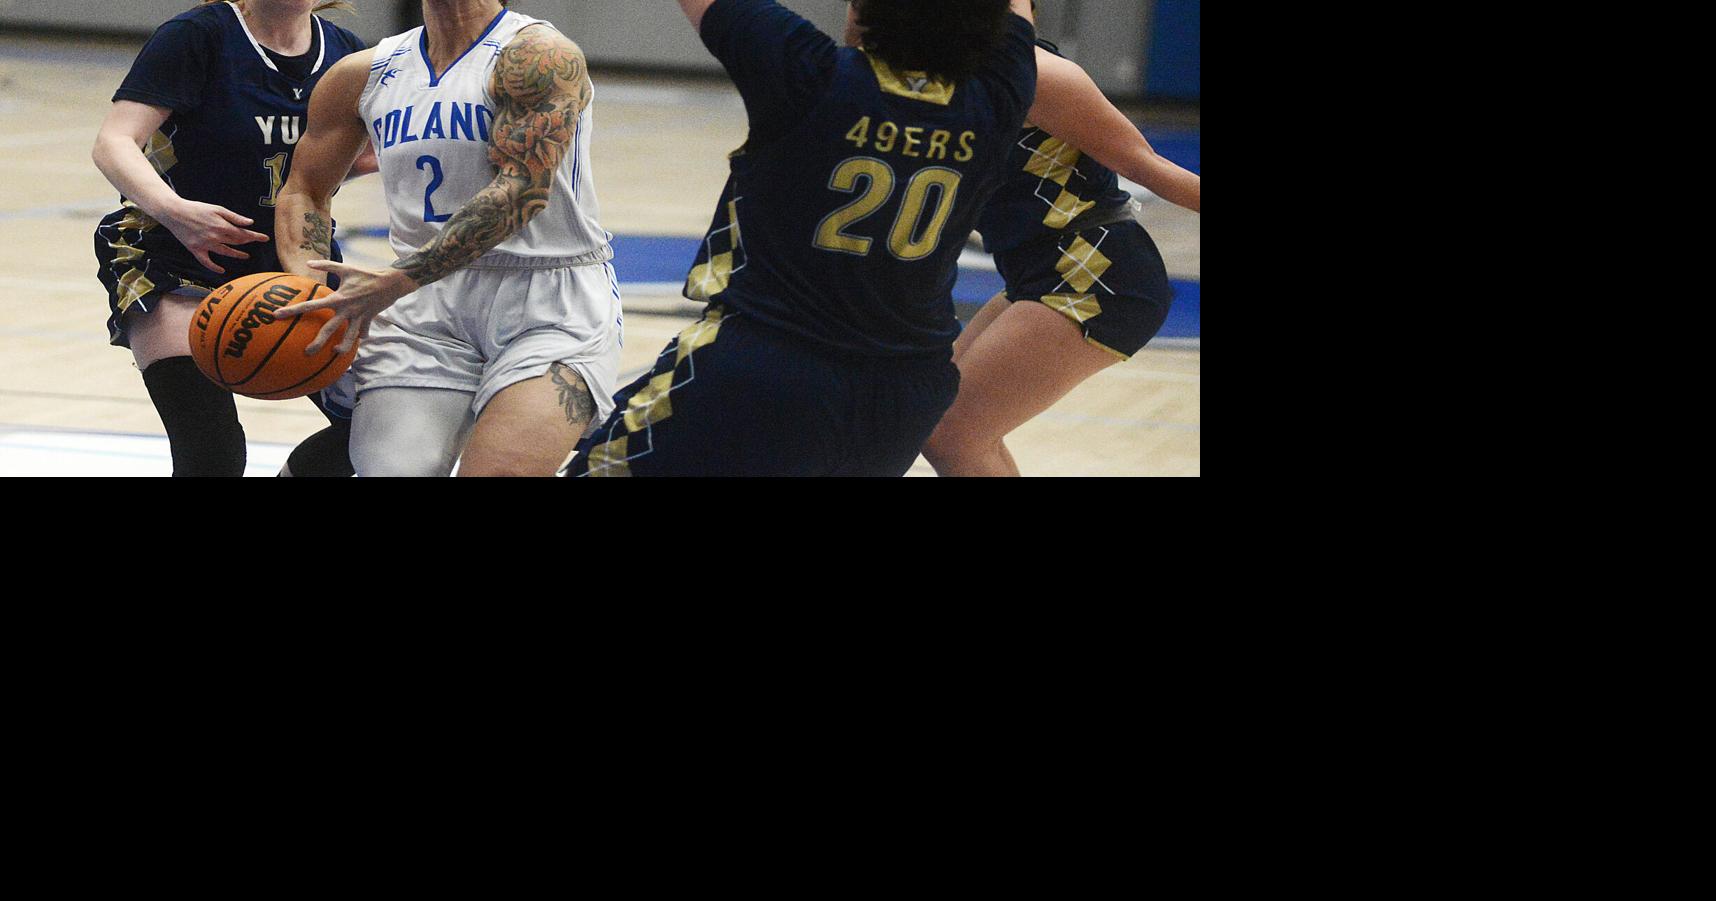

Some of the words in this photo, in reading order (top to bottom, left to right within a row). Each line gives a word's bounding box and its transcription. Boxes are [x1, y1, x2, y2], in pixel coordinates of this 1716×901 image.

[845, 115, 976, 162] 49ERS
[415, 154, 454, 222] 2
[812, 155, 963, 261] 20
[196, 284, 234, 331] EVO
[223, 284, 302, 358] Wilson
